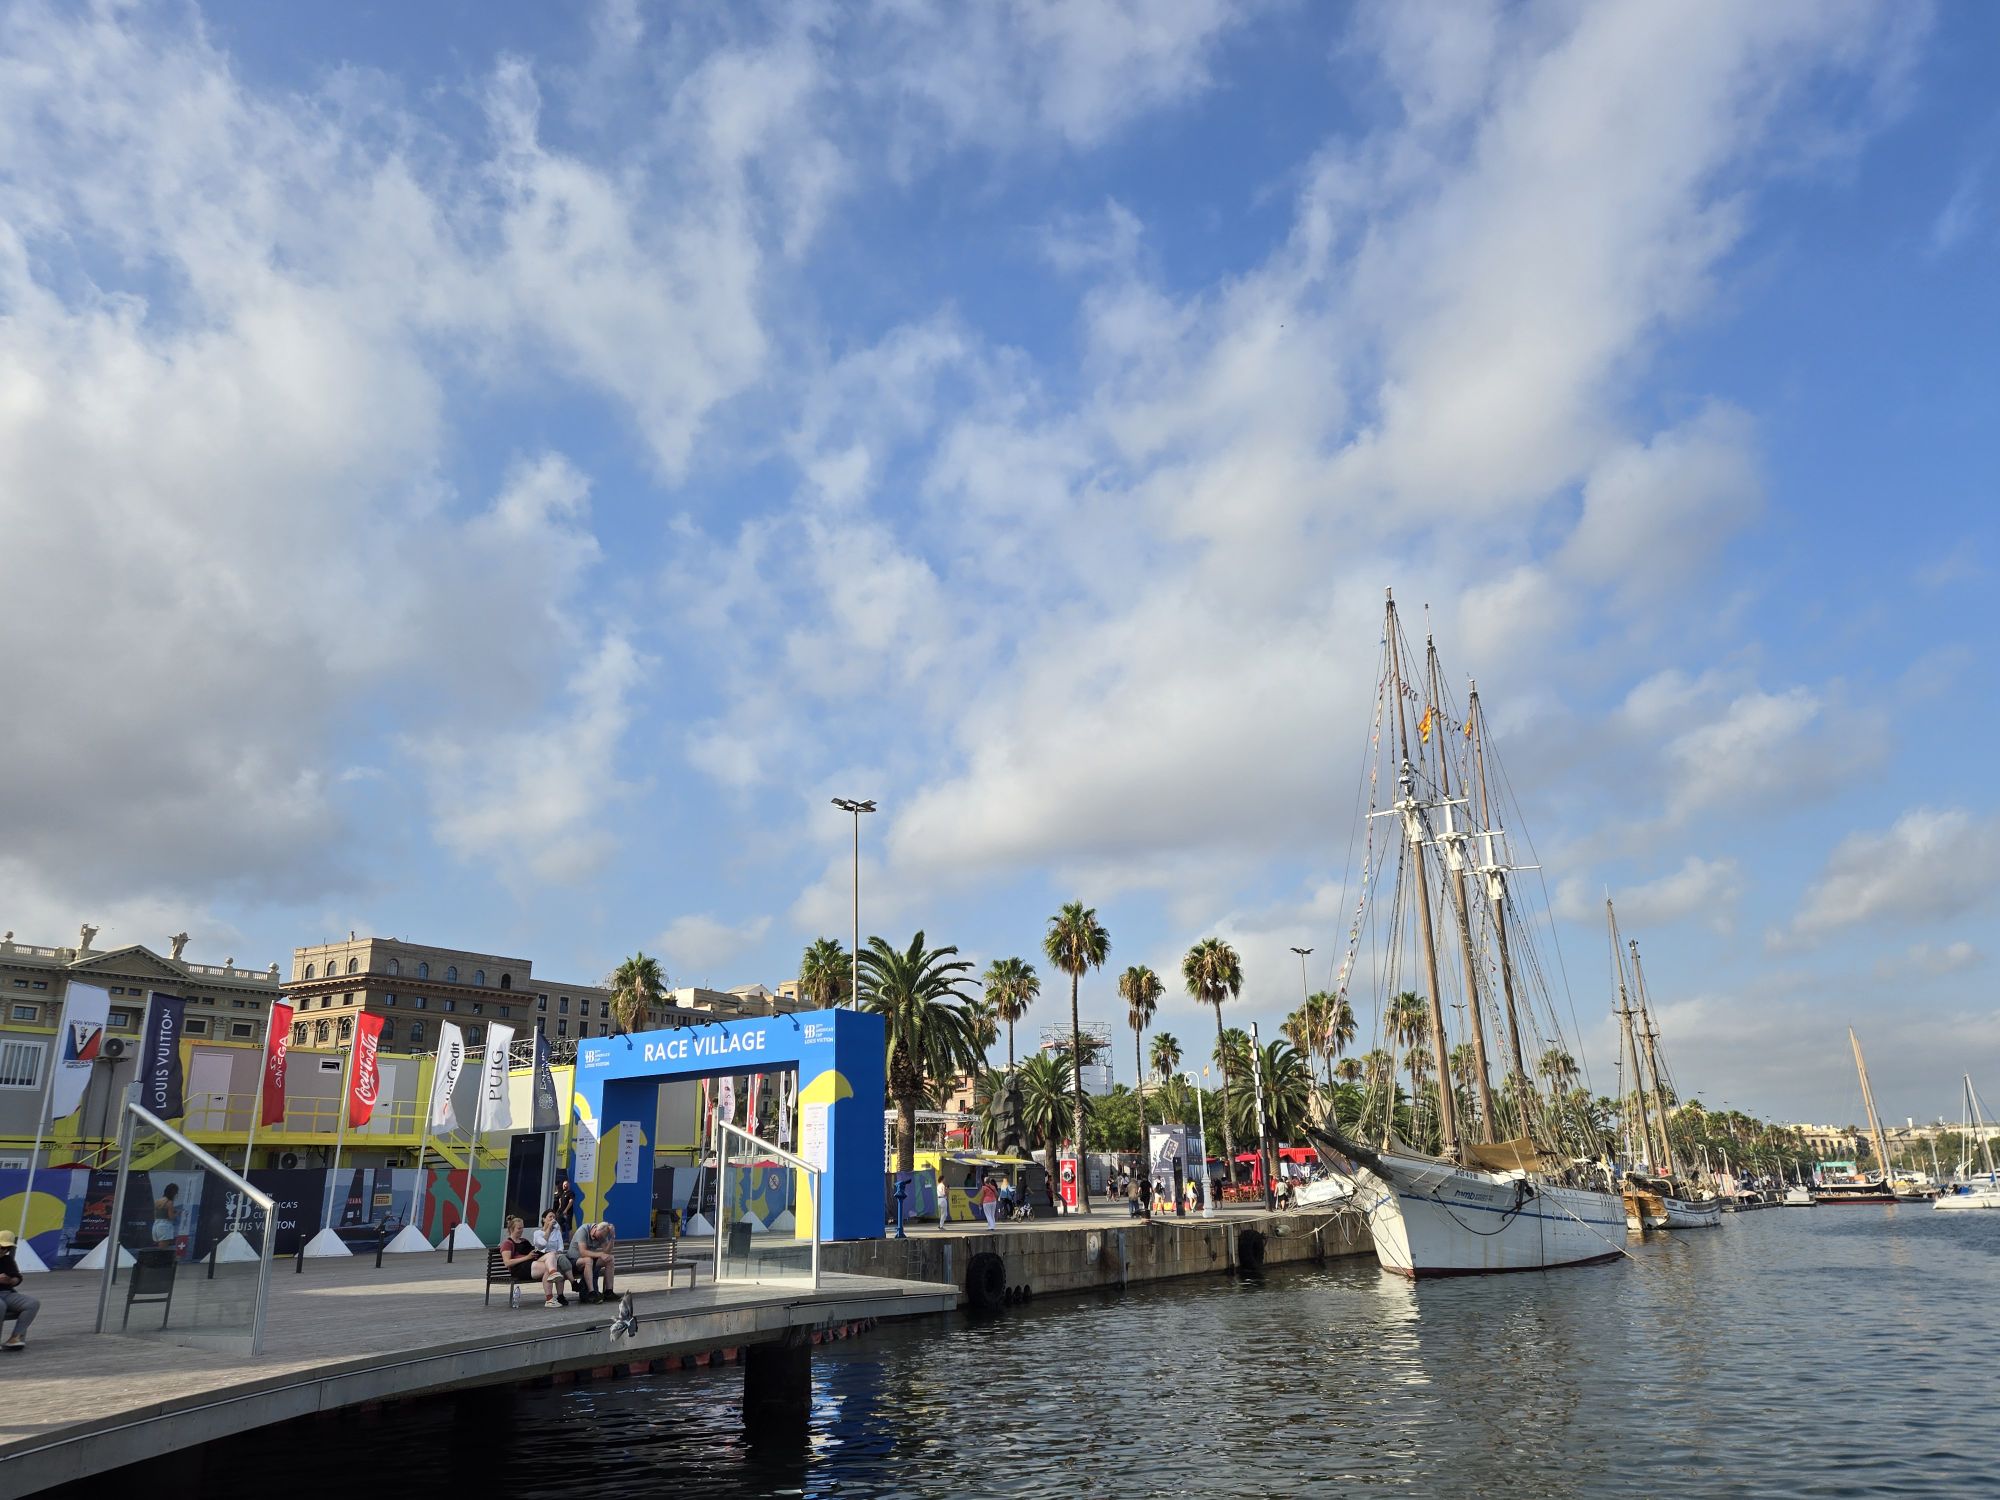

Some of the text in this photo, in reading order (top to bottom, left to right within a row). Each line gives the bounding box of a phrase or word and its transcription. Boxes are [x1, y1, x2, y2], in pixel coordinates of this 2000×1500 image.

[155, 1008, 173, 1109] LOUIS VUITTON
[354, 1029, 378, 1105] Coca-Cola
[644, 1030, 766, 1063] RACE VILLAGE
[488, 1050, 504, 1101] PUIG
[223, 1220, 296, 1232] LOUIS VUTON
[254, 1201, 299, 1211] AICA'S
